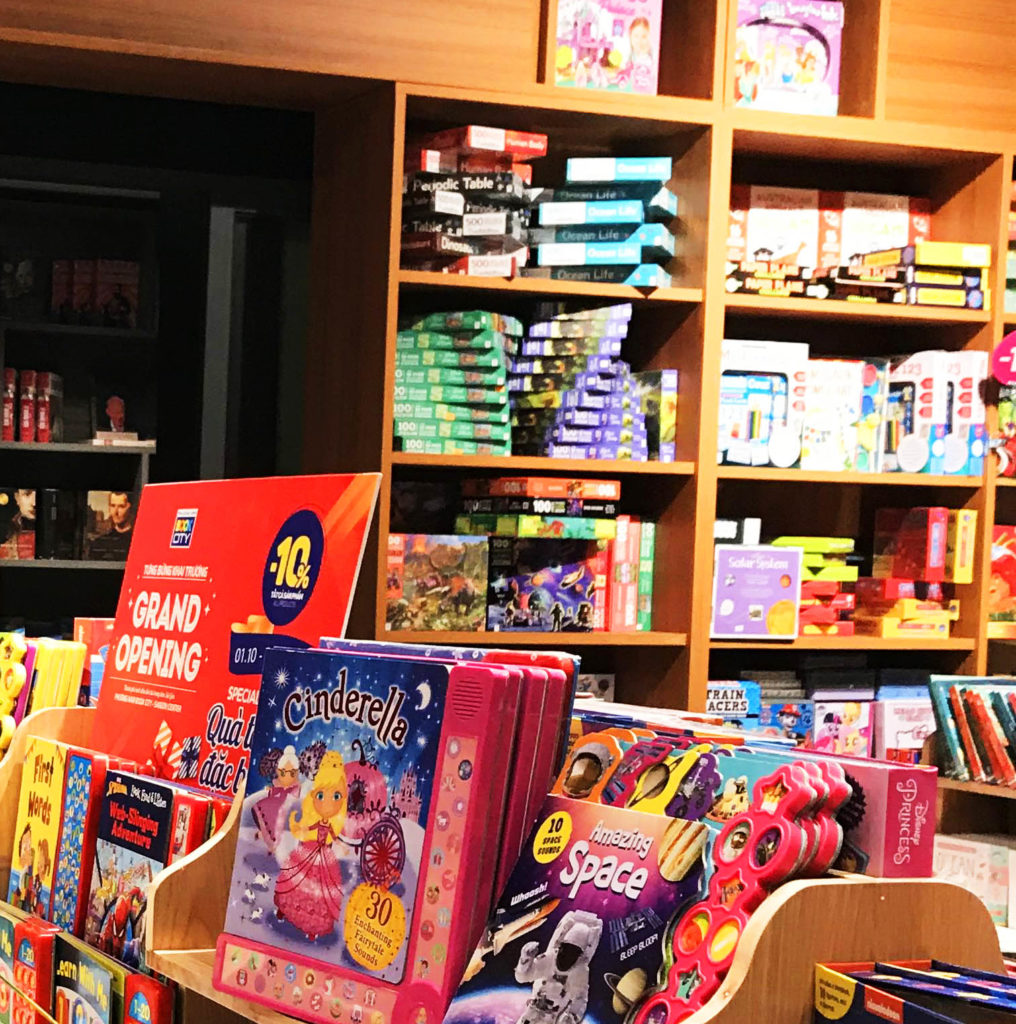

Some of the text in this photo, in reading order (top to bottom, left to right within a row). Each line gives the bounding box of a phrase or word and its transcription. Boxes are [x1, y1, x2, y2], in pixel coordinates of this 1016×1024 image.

[463, 175, 494, 190] Table
[596, 189, 617, 200] Life
[561, 229, 620, 241] Ocean Life
[594, 268, 614, 280] Life
[398, 421, 416, 432] 100
[405, 440, 423, 449] 100
[533, 500, 552, 513] 100
[174, 518, 194, 532] BOOK
[171, 532, 192, 546] CITY
[269, 535, 311, 589] -10%
[728, 555, 789, 571] Solar System
[132, 590, 202, 633] GRAND
[114, 633, 202, 682] OPENING
[234, 648, 257, 664] 01.10
[227, 685, 260, 704] SPECIAL
[706, 689, 744, 700] TRAIN
[707, 701, 748, 711] ACERS
[283, 666, 409, 748] Cinderella
[206, 703, 243, 747] Quà
[33, 753, 55, 787] First
[199, 749, 234, 793] đặc
[28, 791, 51, 826] Words
[547, 817, 564, 834] 10
[893, 778, 917, 865] PRINCESS
[909, 800, 929, 846] Disney
[111, 820, 152, 850] Adventure
[542, 835, 562, 845] SPACE
[588, 820, 654, 860] Amazing
[537, 846, 561, 856] SOUNDS
[559, 840, 649, 900] Space
[510, 881, 549, 907] Whoosh!
[365, 890, 393, 926] 30
[353, 914, 393, 949] Enchanting
[353, 929, 385, 956] Fairytale
[0, 934, 12, 958] Me
[353, 942, 379, 966] Sounds
[57, 959, 108, 1011] earn With Me
[133, 1003, 152, 1022] 1-20
[866, 999, 901, 1021] nickelodeon
